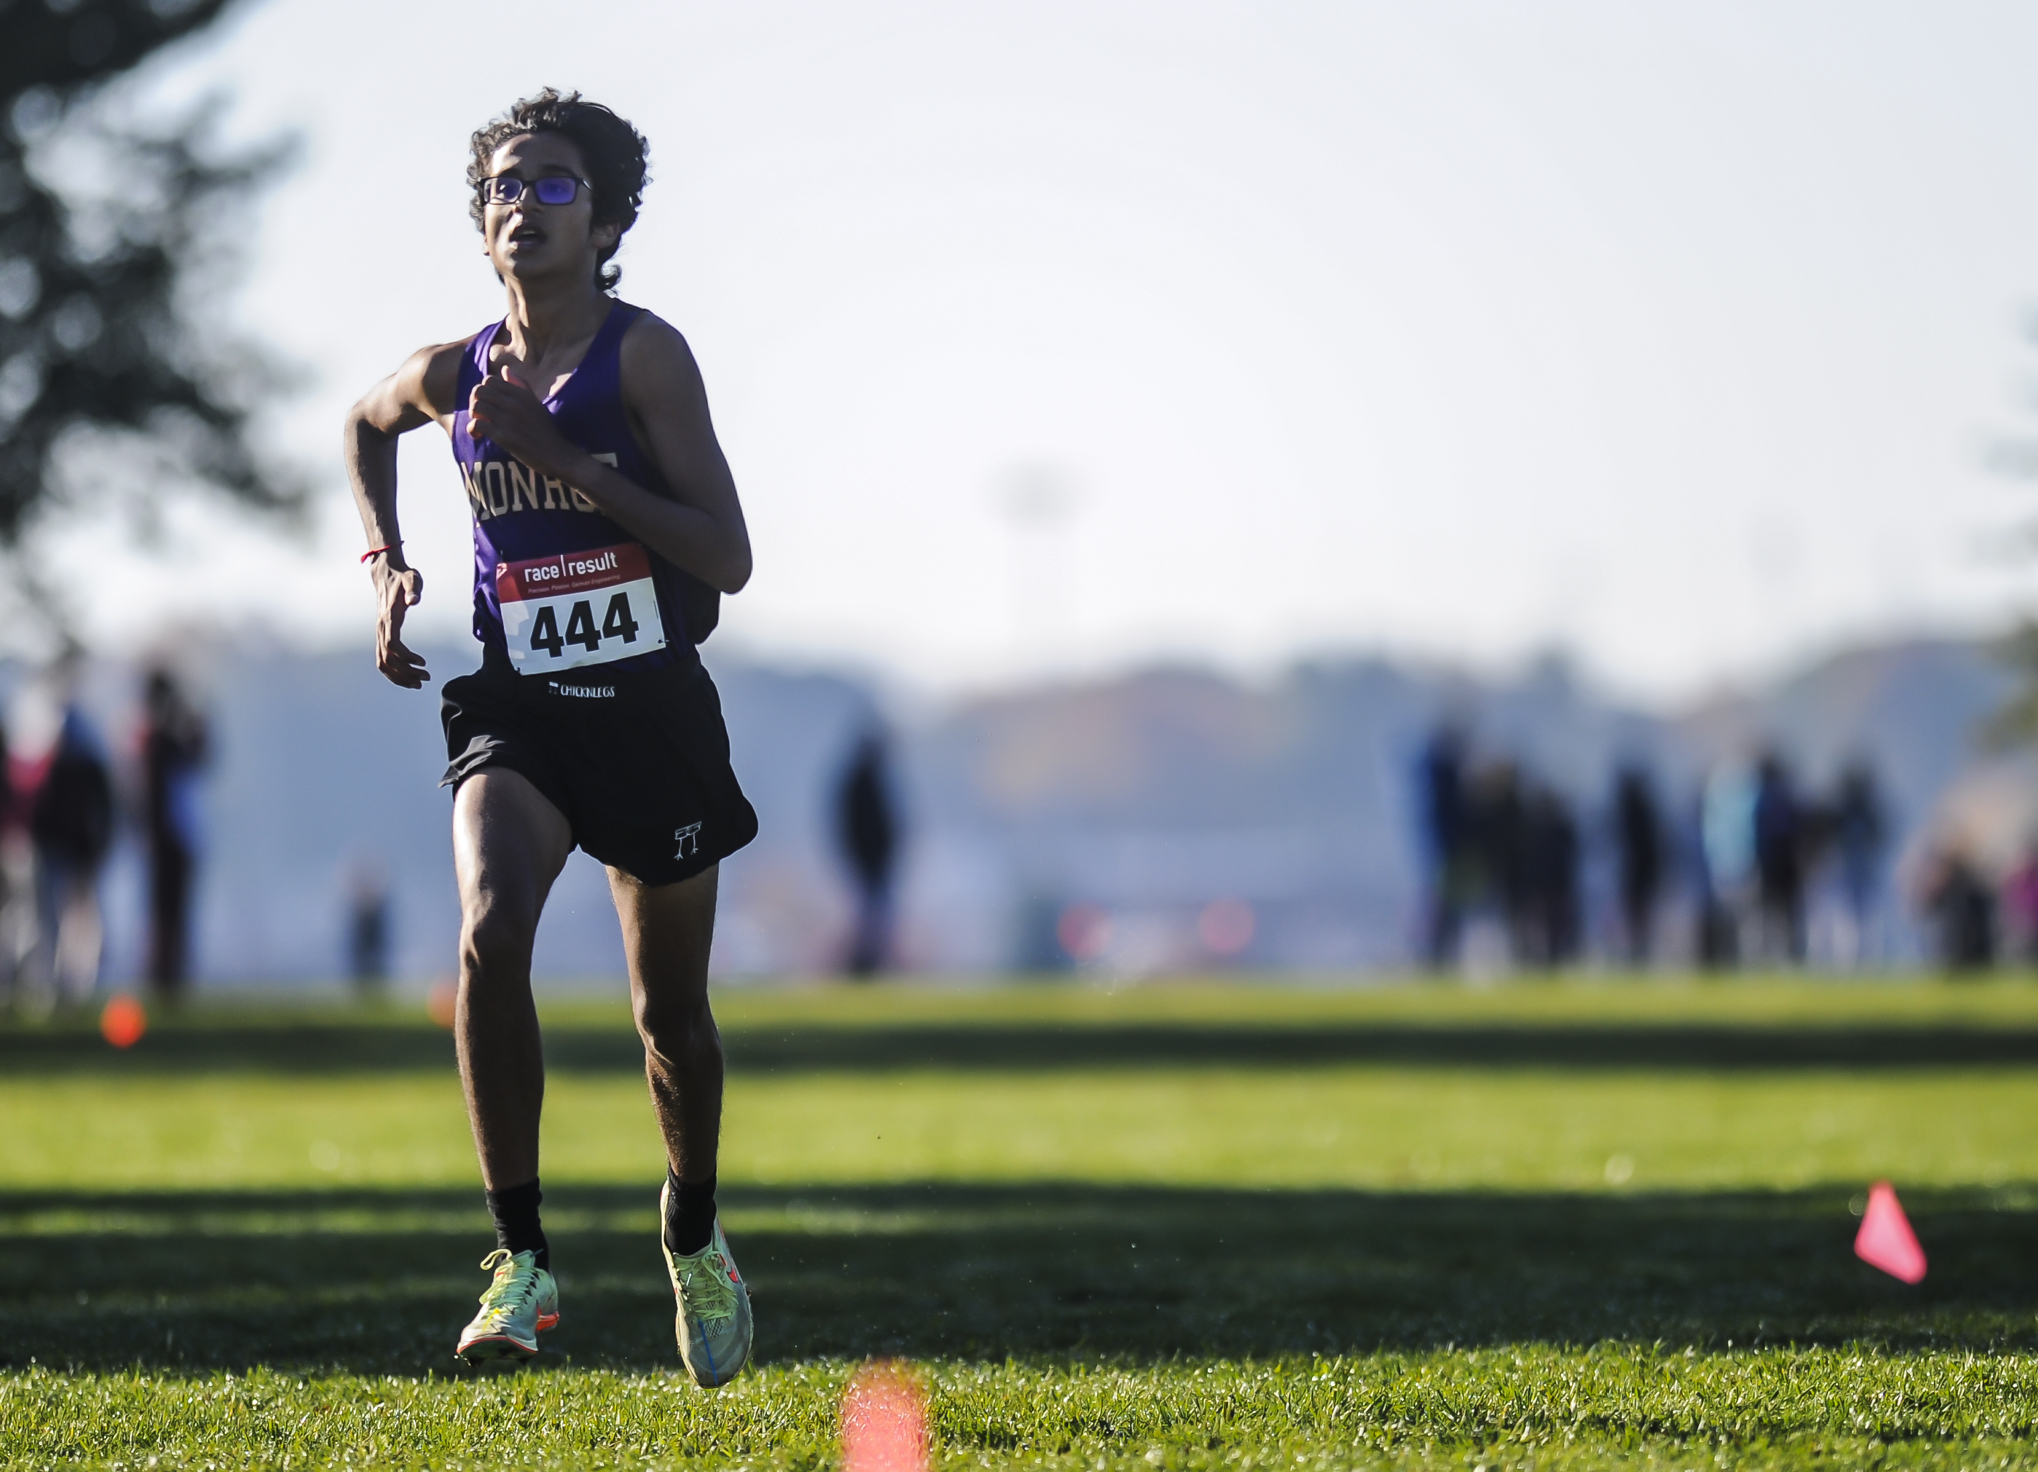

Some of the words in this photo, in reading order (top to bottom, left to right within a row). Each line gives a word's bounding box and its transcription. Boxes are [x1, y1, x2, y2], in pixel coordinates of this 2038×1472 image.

[460, 452, 618, 521] MONR
[530, 591, 639, 659] 444
[560, 684, 615, 698] CHICKNLEGS
